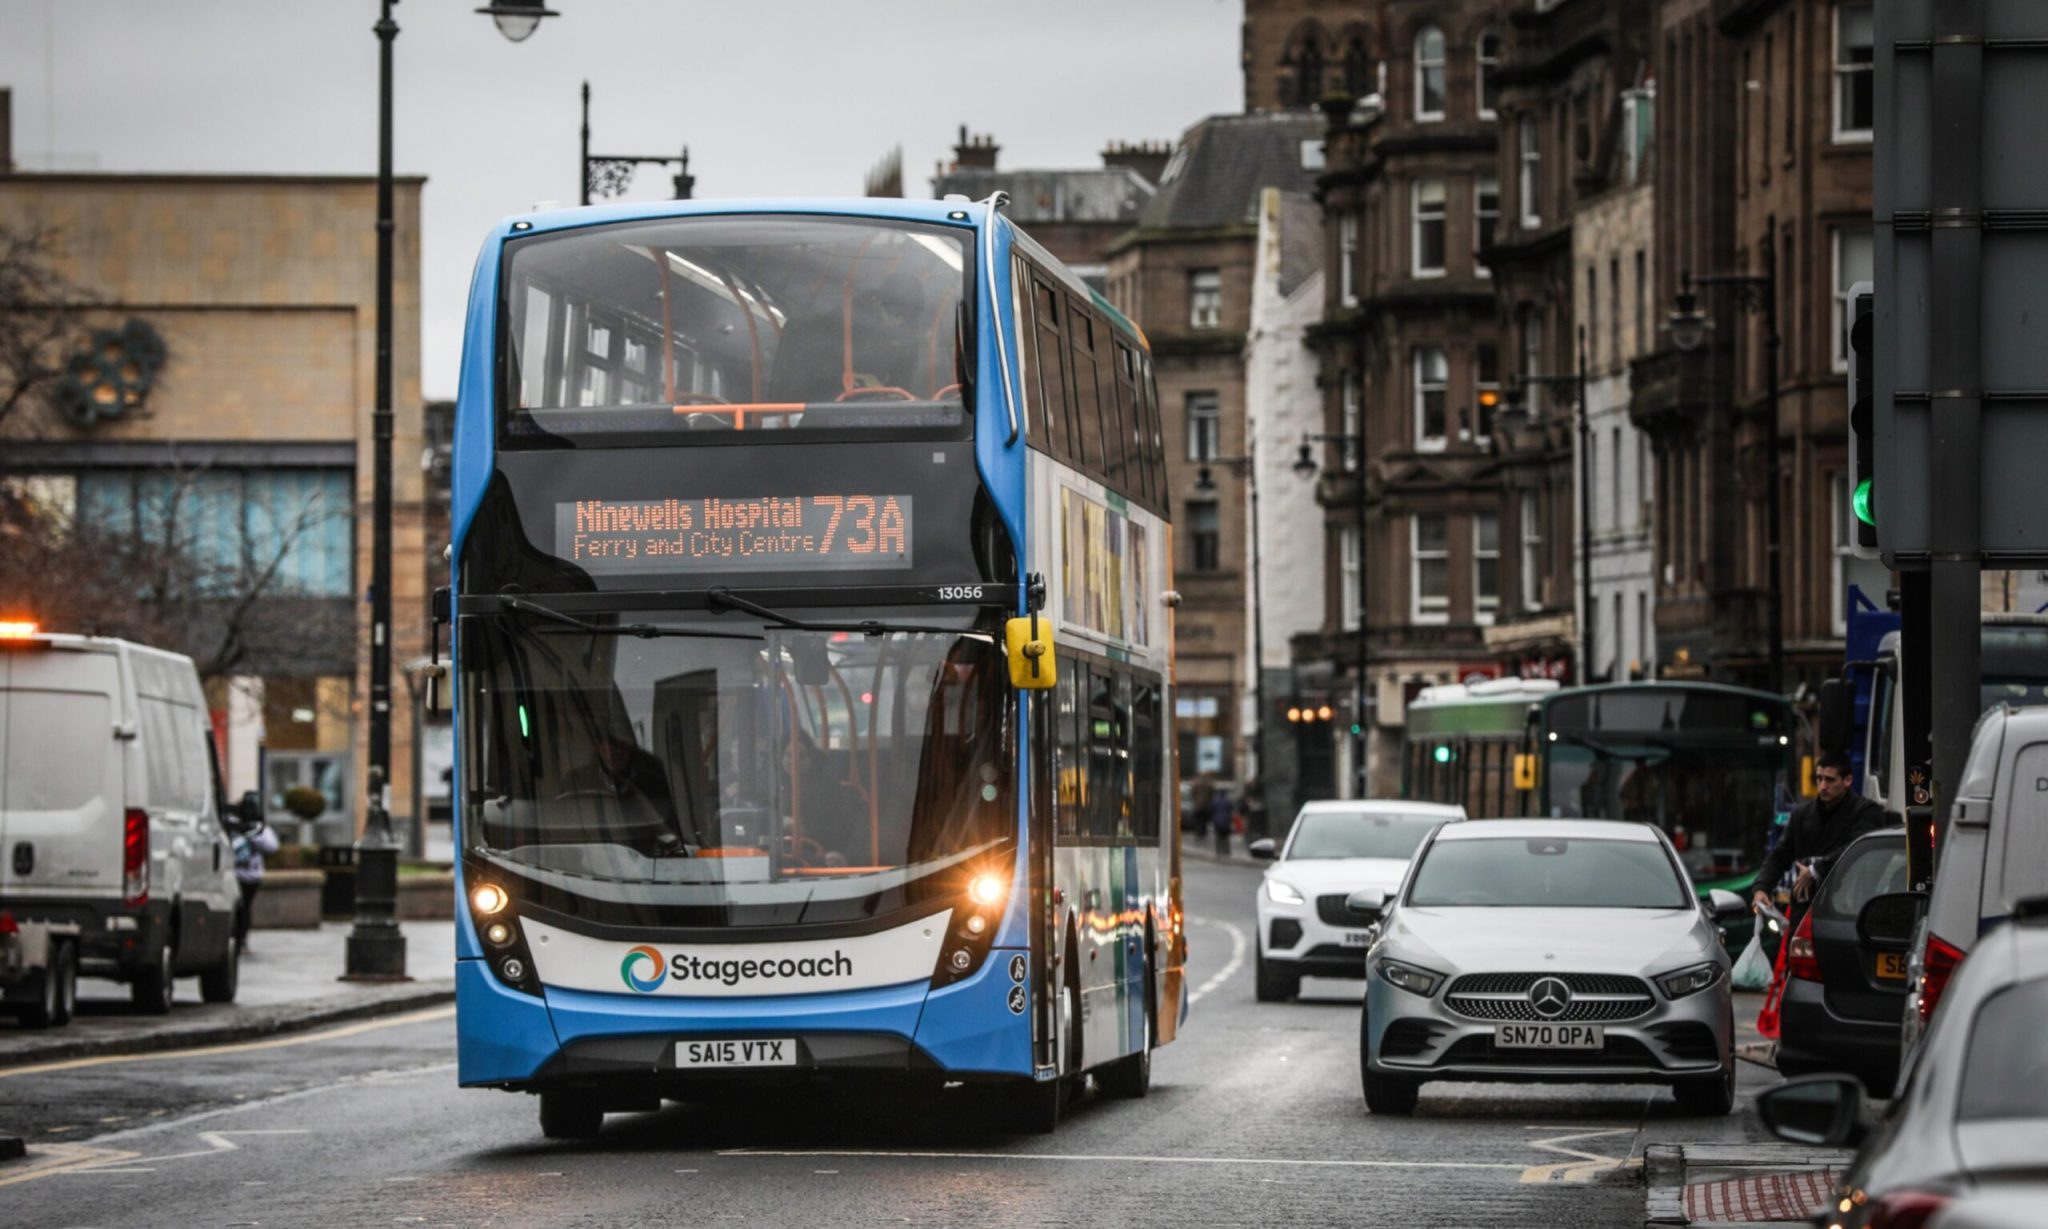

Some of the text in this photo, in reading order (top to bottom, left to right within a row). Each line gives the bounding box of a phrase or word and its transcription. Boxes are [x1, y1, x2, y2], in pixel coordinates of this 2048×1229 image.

[576, 496, 802, 532] Ninewells Hospital
[813, 495, 905, 554] 73A
[574, 530, 814, 560] Ferry and City Centre
[937, 586, 983, 600] 13056
[670, 950, 853, 986] Stagecoach
[1502, 1026, 1595, 1045] SN70 OPA
[688, 1041, 783, 1063] SA15 VTX
